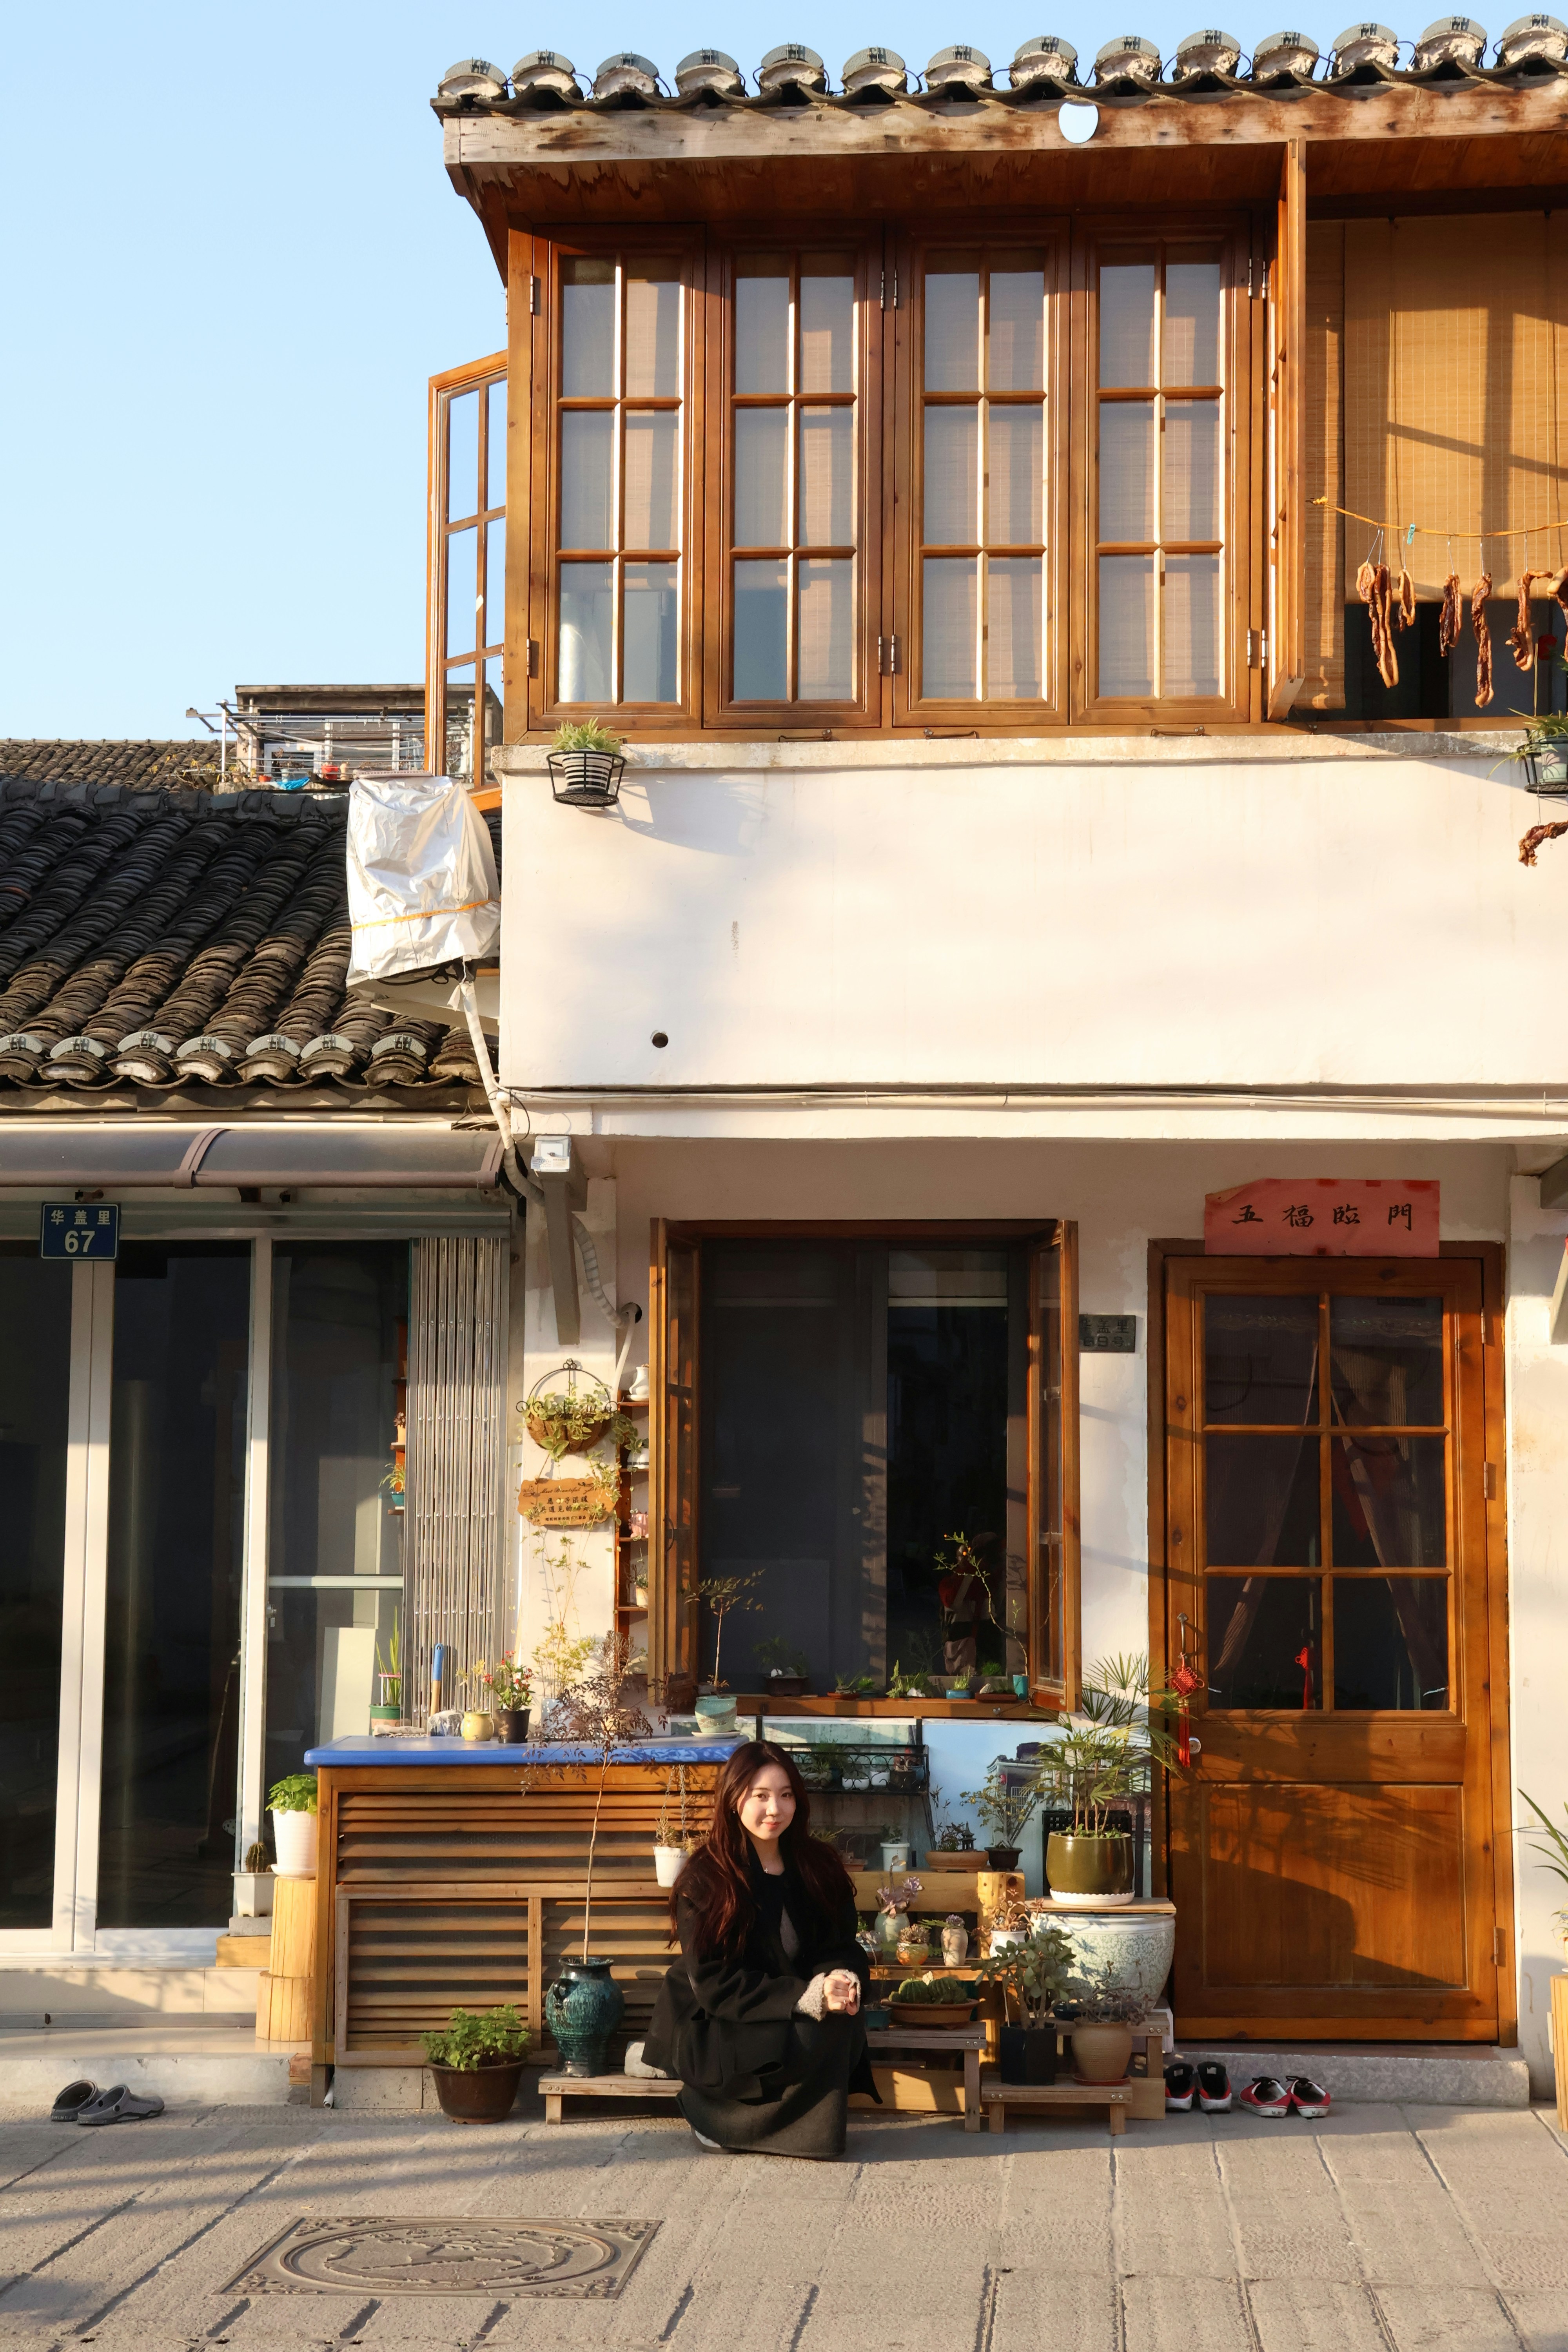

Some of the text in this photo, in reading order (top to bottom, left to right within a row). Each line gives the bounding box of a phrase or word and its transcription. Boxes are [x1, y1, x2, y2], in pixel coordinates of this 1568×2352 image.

[51, 1209, 111, 1225] 华盖里
[1232, 1203, 1413, 1231] 五福臨門
[64, 1230, 96, 1253] 67
